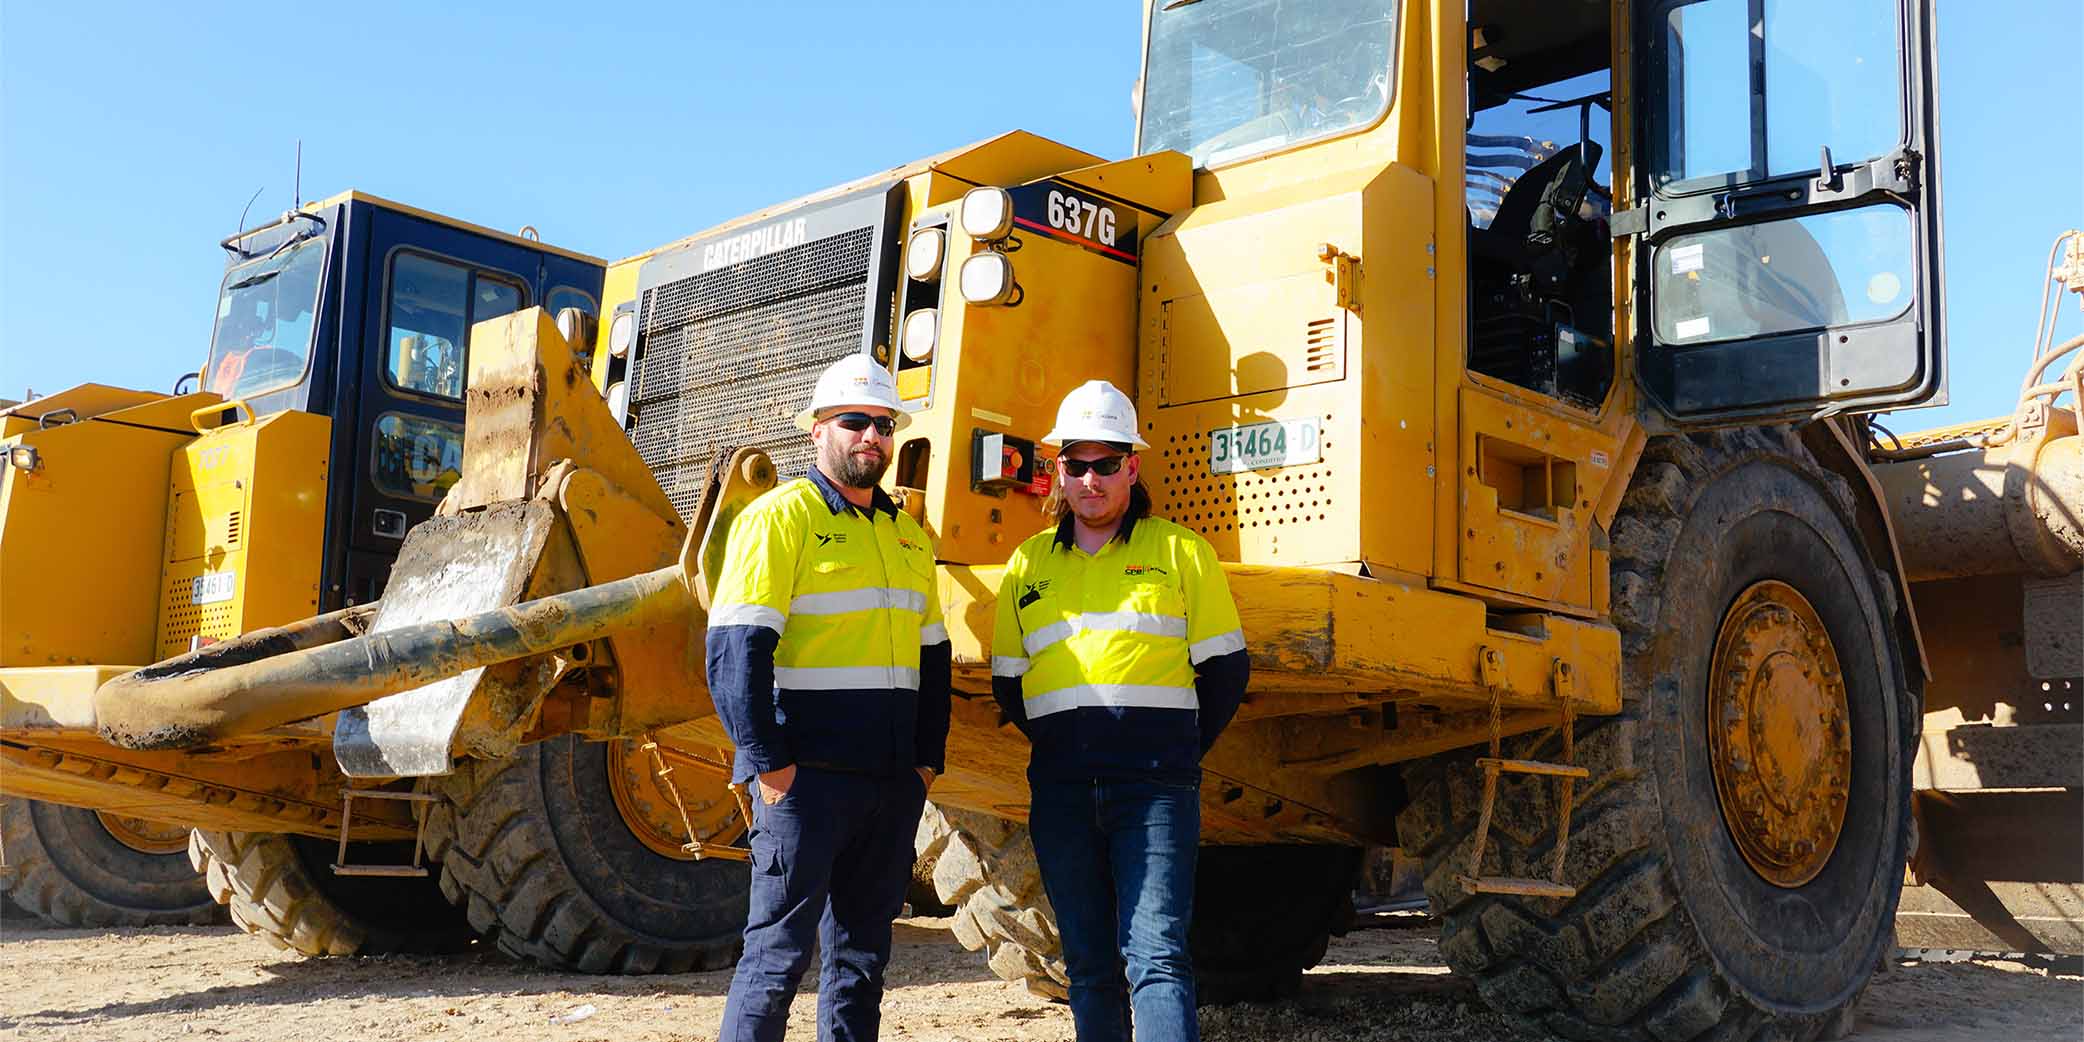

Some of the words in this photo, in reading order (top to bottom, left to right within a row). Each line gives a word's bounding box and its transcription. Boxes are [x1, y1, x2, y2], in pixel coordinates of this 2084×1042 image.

[704, 218, 807, 271] CATERPILLAR
[1048, 190, 1116, 248] 637G
[1216, 426, 1287, 462] 35464
[1301, 423, 1316, 451] D
